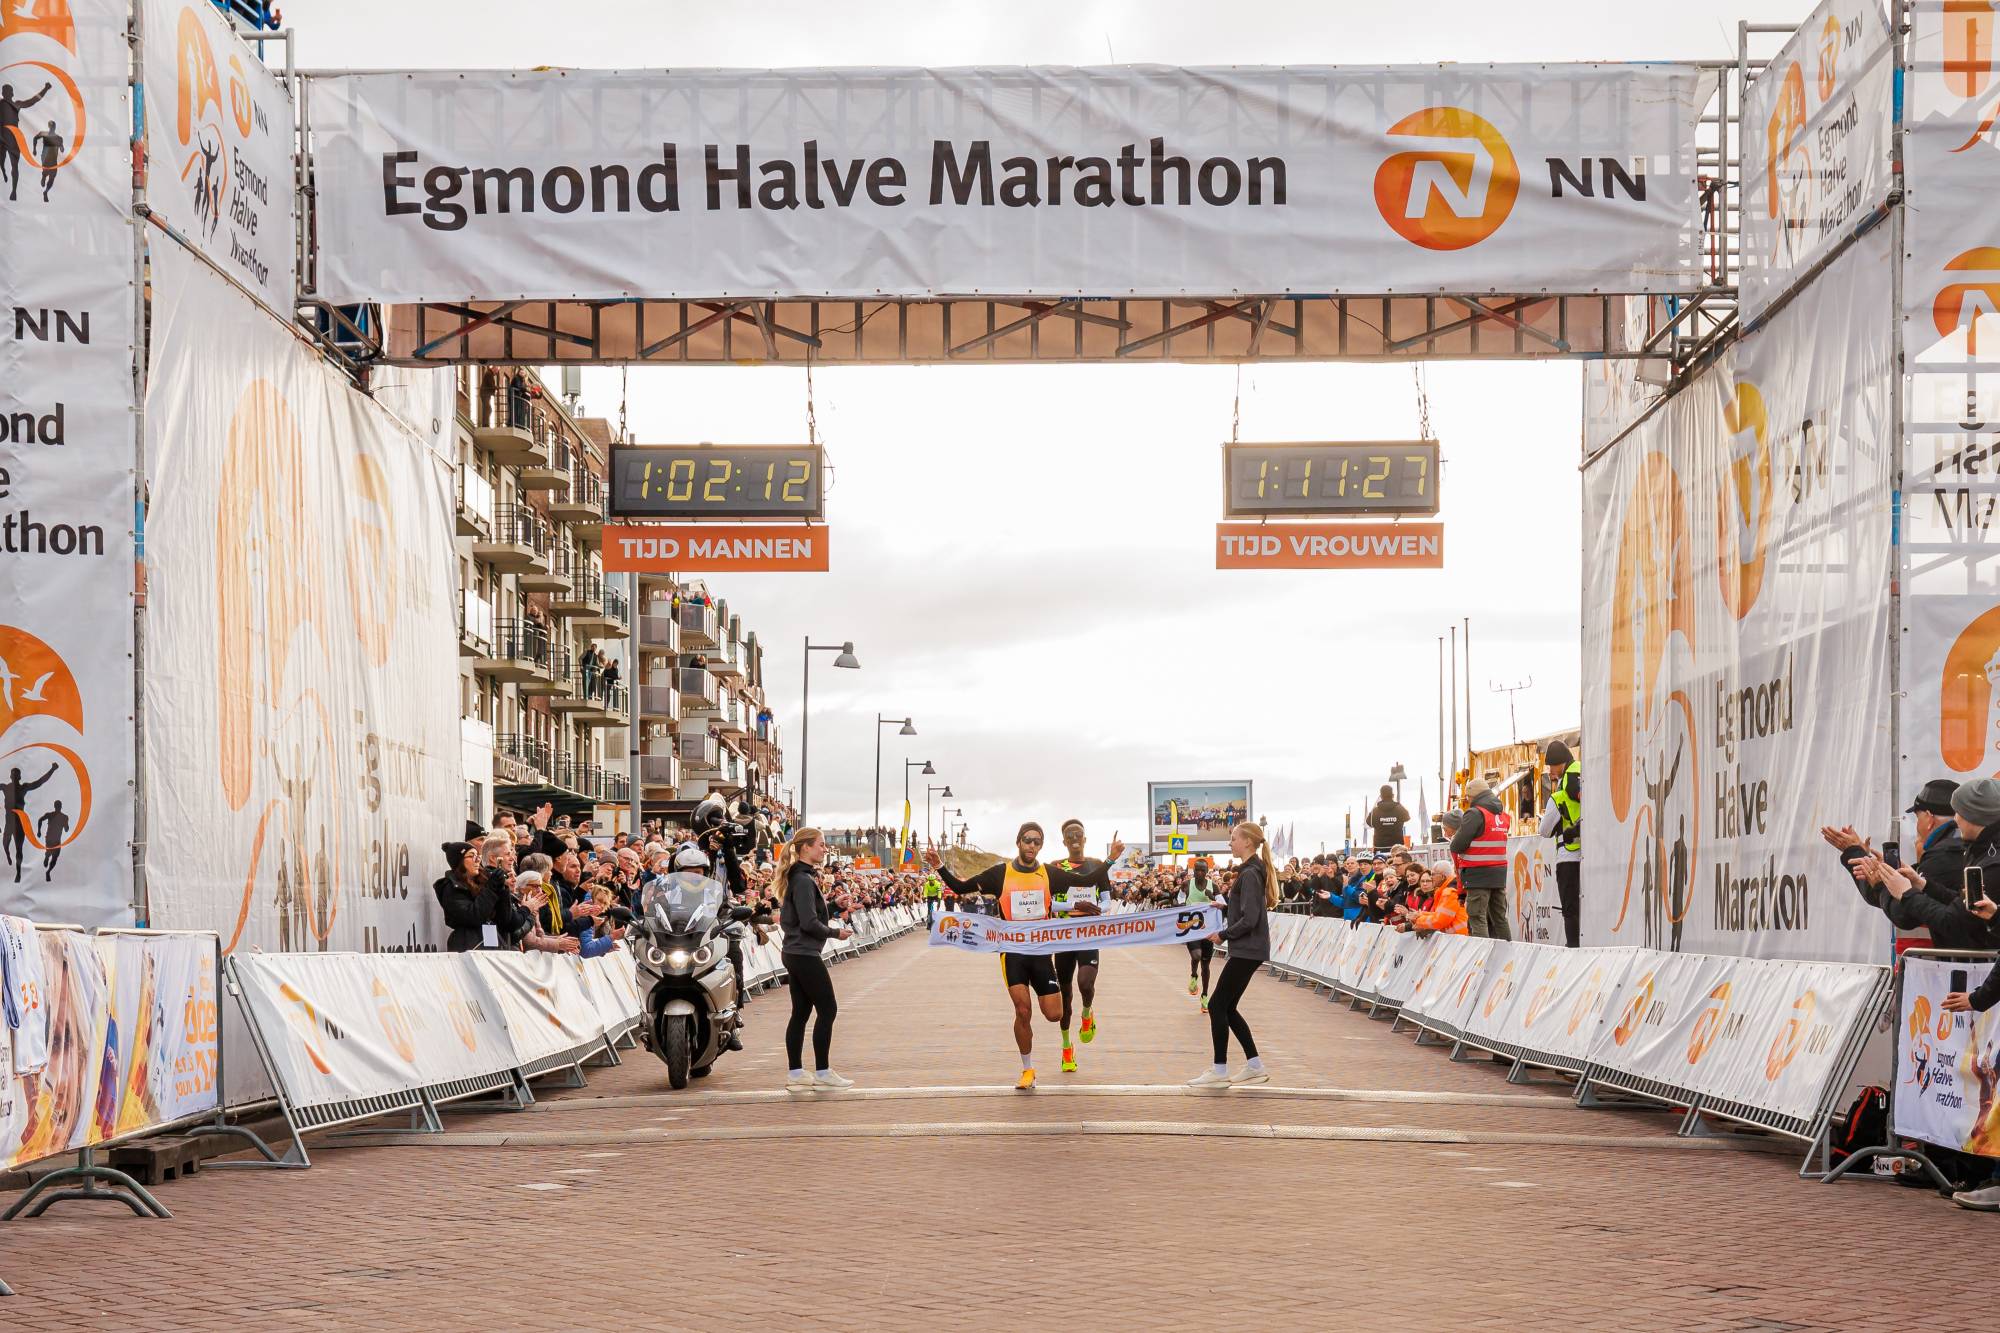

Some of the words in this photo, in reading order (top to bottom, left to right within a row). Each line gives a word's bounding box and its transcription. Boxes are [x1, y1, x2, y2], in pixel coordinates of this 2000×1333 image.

[1818, 91, 1859, 161] Egmond
[233, 145, 268, 206] Egmond
[382, 142, 680, 231] Egmond
[704, 139, 907, 212] Halve
[929, 136, 1287, 208] Marathon
[1545, 157, 1647, 202] NN
[1819, 156, 1848, 201] Halve
[229, 186, 258, 237] Halve
[1817, 179, 1863, 244] Marathon
[13, 306, 90, 345] NN
[641, 459, 810, 502] 1:02:12
[1257, 456, 1428, 499] 1:11:27
[0, 509, 104, 556] thon
[618, 538, 680, 559] TIJD
[688, 538, 812, 559] MANNEN
[1220, 535, 1282, 556] TIJD
[1289, 535, 1438, 556] VROUWEN
[1716, 652, 1794, 764] Egmond
[1715, 764, 1769, 840] Halve
[1714, 855, 1808, 932] Marathon
[1030, 927, 1072, 943] HALVE
[1076, 919, 1156, 939] MARATHON
[1931, 1066, 1953, 1087] Halve
